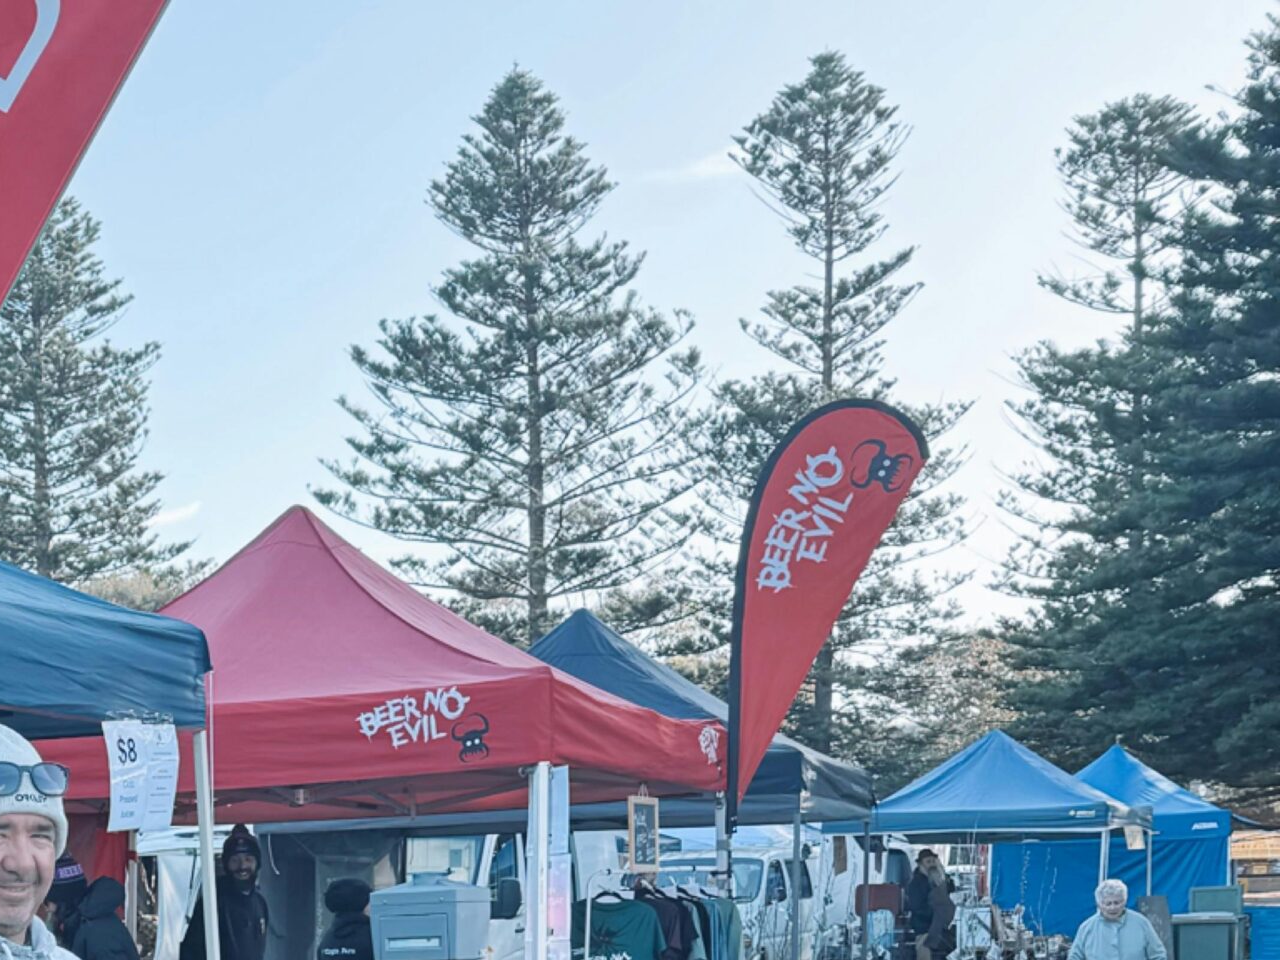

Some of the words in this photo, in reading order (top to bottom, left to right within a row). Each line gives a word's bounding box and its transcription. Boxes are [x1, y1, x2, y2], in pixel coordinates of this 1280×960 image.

[756, 507, 812, 593] BEER
[788, 446, 845, 505] NO
[797, 493, 854, 562] EVIL
[355, 695, 422, 742] BEER
[423, 686, 470, 720] NO
[386, 714, 447, 749] EVIL
[117, 735, 137, 766] $8
